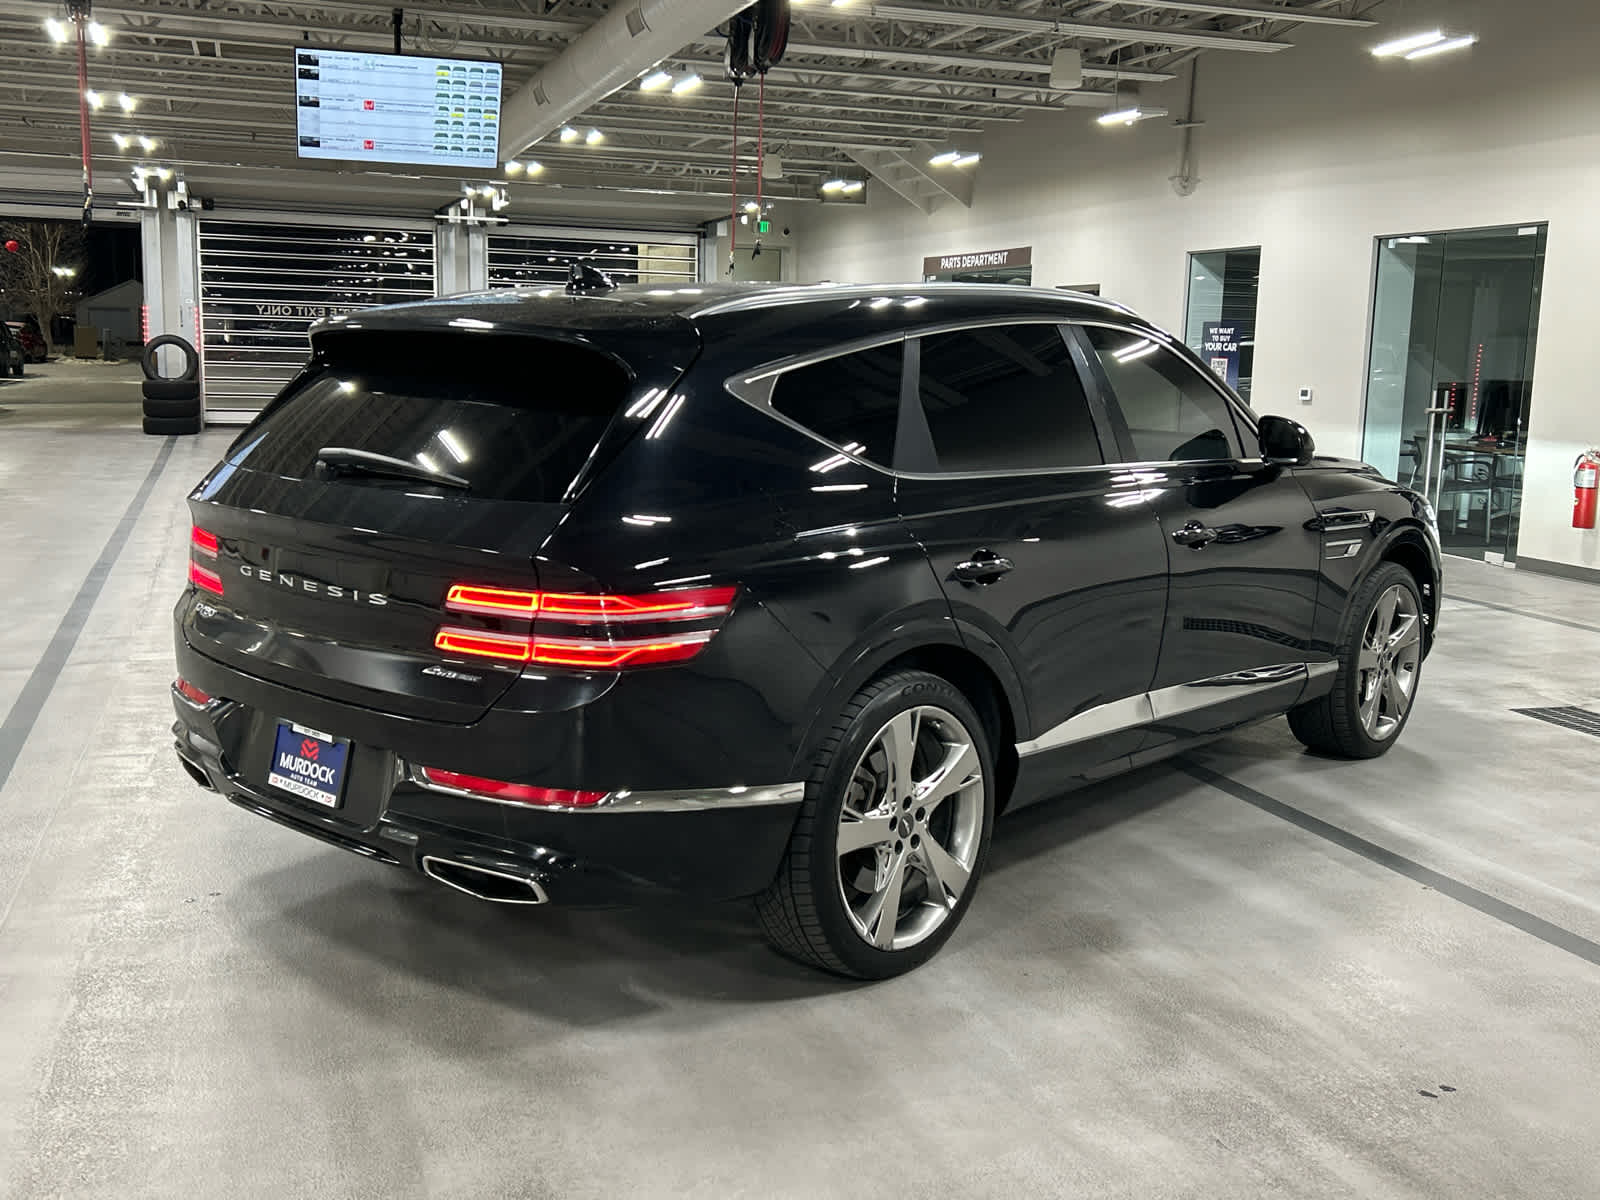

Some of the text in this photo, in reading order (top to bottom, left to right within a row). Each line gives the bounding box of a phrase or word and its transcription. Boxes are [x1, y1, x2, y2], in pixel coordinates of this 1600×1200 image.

[940, 252, 1008, 269] PARTS DEPARTMENT
[1204, 342, 1237, 352] YOUR CAR
[239, 565, 388, 606] GENESIS
[279, 751, 336, 785] MURDOCK
[290, 772, 318, 787] AUTO TEAM
